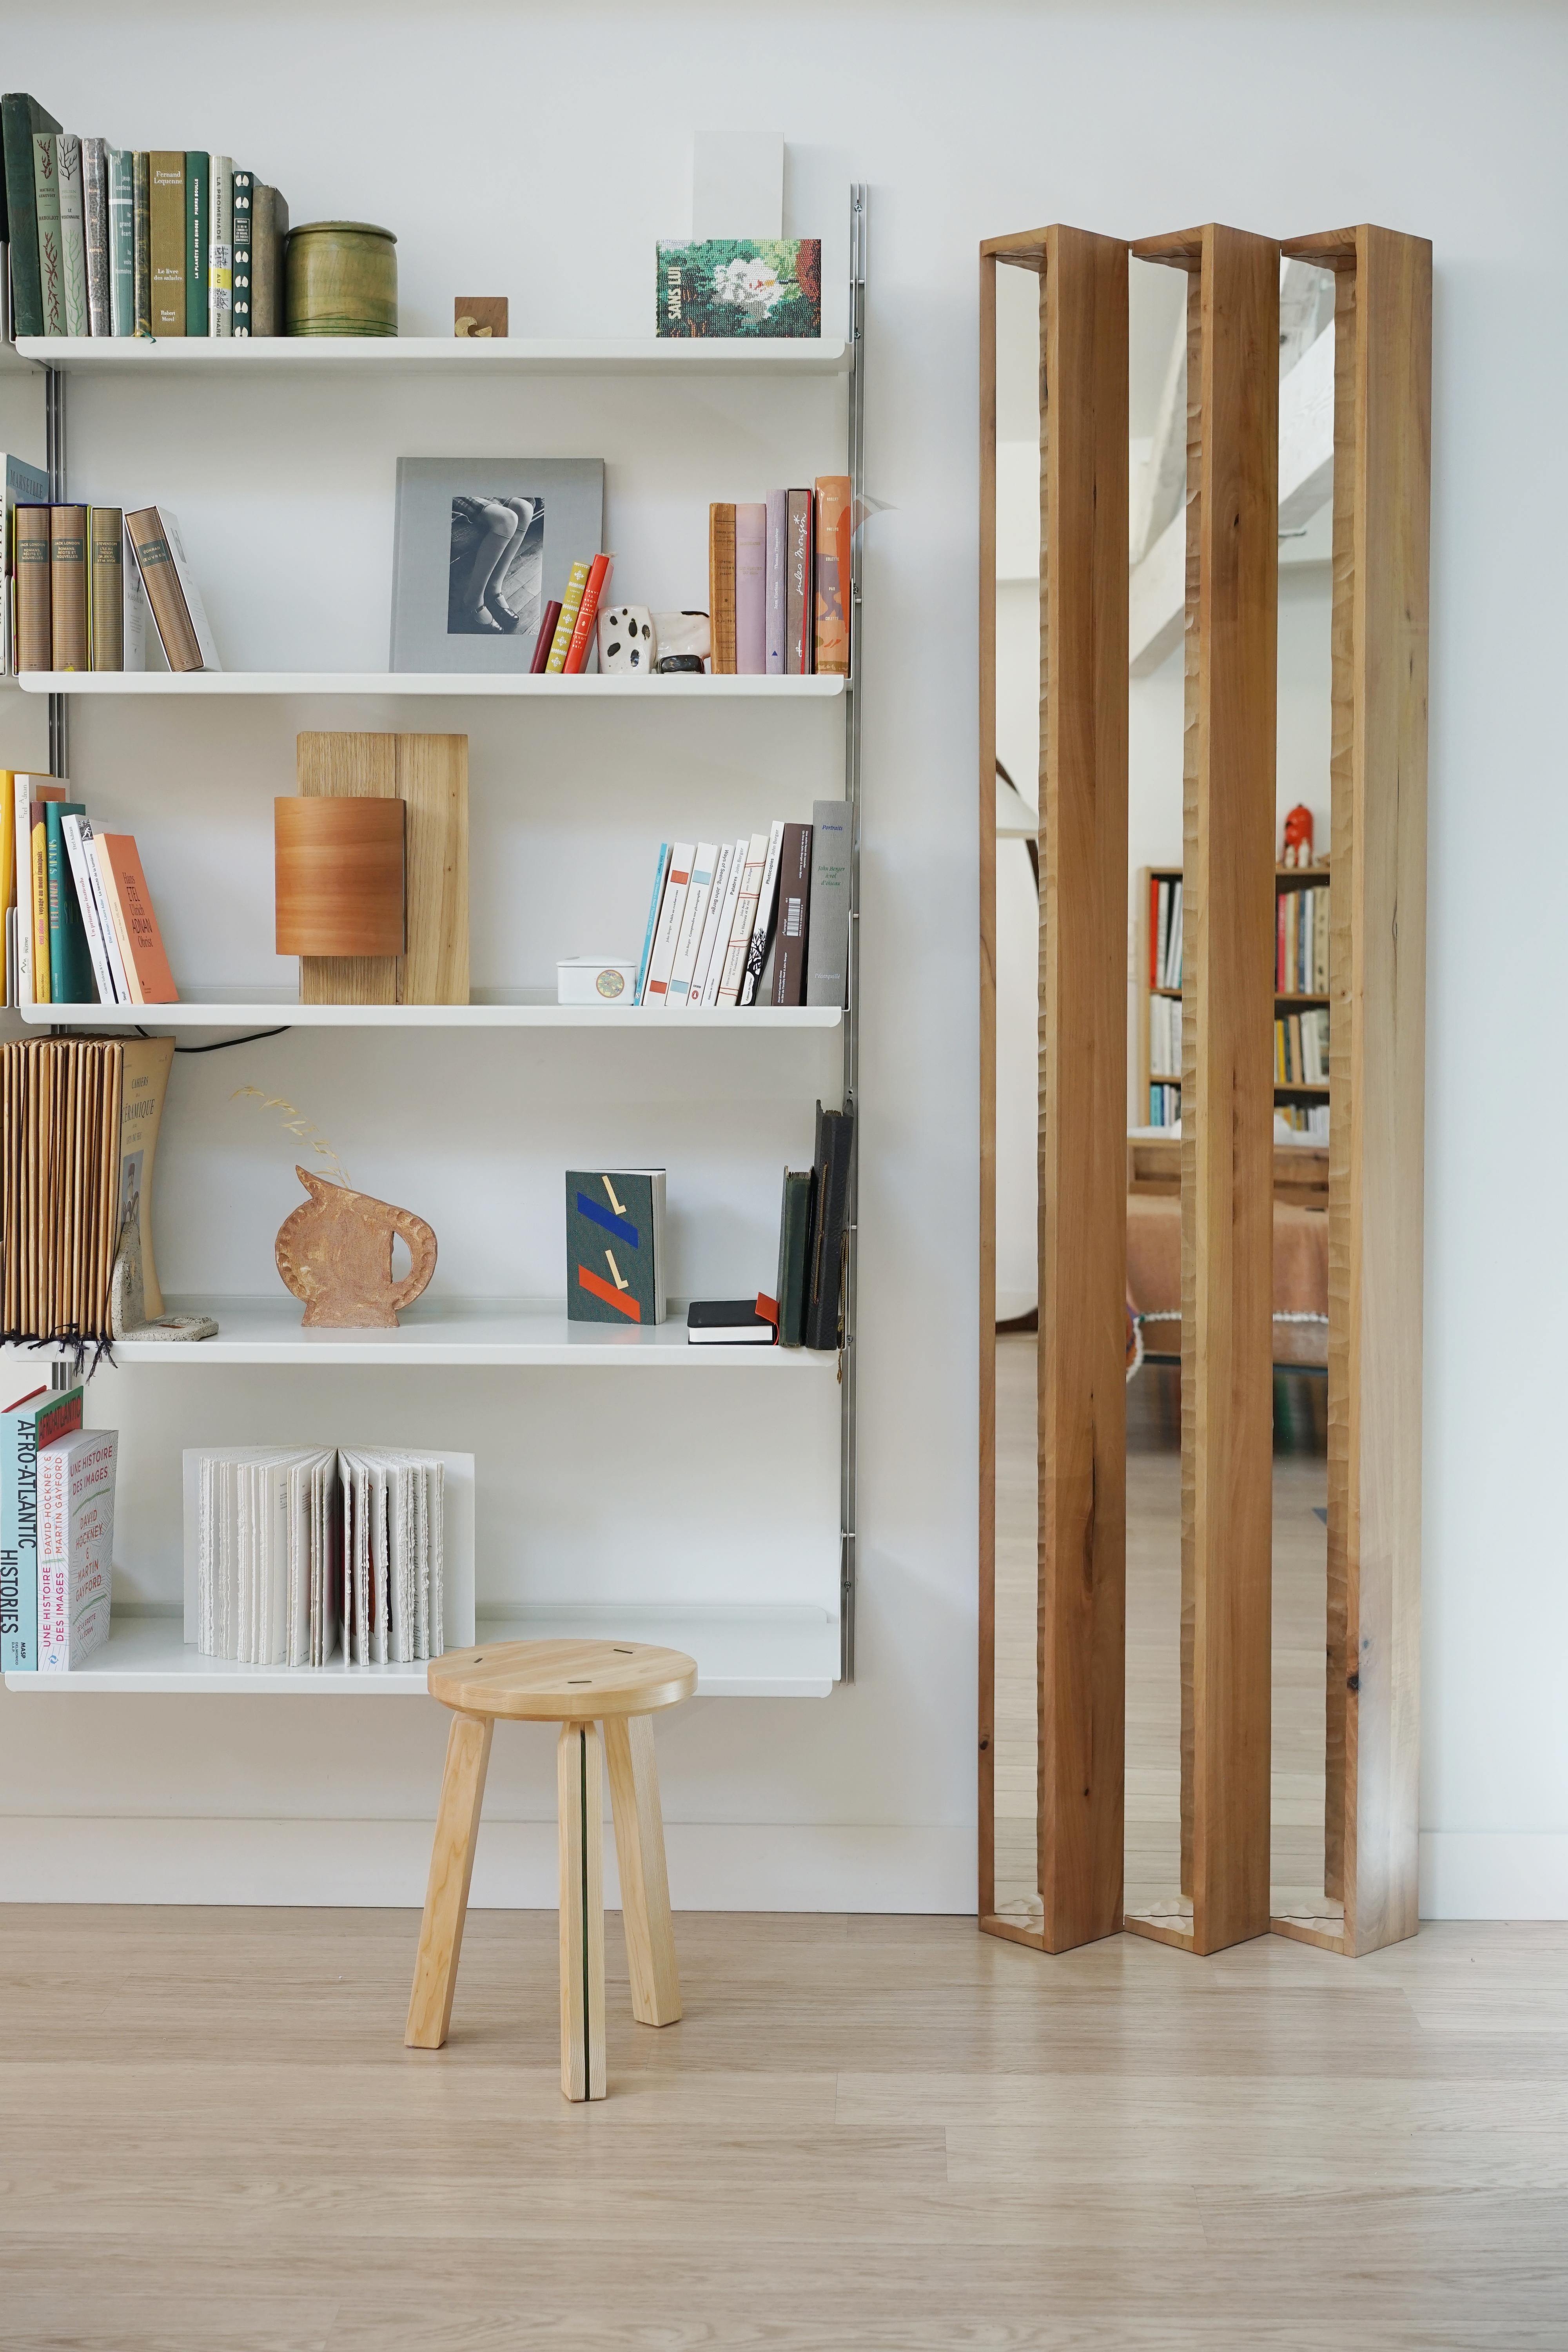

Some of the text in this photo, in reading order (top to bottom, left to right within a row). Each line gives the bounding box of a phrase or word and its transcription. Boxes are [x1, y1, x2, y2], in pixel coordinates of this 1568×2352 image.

[216, 177, 221, 186] LA
[217, 274, 221, 283] AU
[668, 267, 681, 319] SANS LUI
[10, 470, 43, 499] MARSEILLE
[143, 553, 165, 562] ŒUVRES
[19, 784, 27, 818] Etel Adnan
[49, 840, 59, 929] ETEL ADNAN SAISONS
[80, 878, 88, 902] inattendu
[122, 872, 135, 884] Hans
[127, 887, 140, 901] ETEL
[84, 902, 96, 929] printemps
[129, 904, 145, 915] Ulrich
[132, 918, 152, 934] ADNAN
[138, 936, 153, 947] Obrist
[132, 1076, 149, 1089] CAHIERS
[122, 1099, 155, 1124] CÉRAMIQUE
[71, 1445, 113, 1477] UNE HISTOIRE
[17, 1420, 36, 1549] AFRO-ATLANTIC
[73, 1466, 108, 1495] DES IMAGES
[80, 1510, 97, 1530] DAVID
[76, 1523, 103, 1550] HOCKNEY
[86, 1547, 89, 1559] &
[78, 1559, 98, 1583] MARTIN
[0, 1550, 18, 1633] HISTORIES
[76, 1575, 102, 1602] GAYFORD
